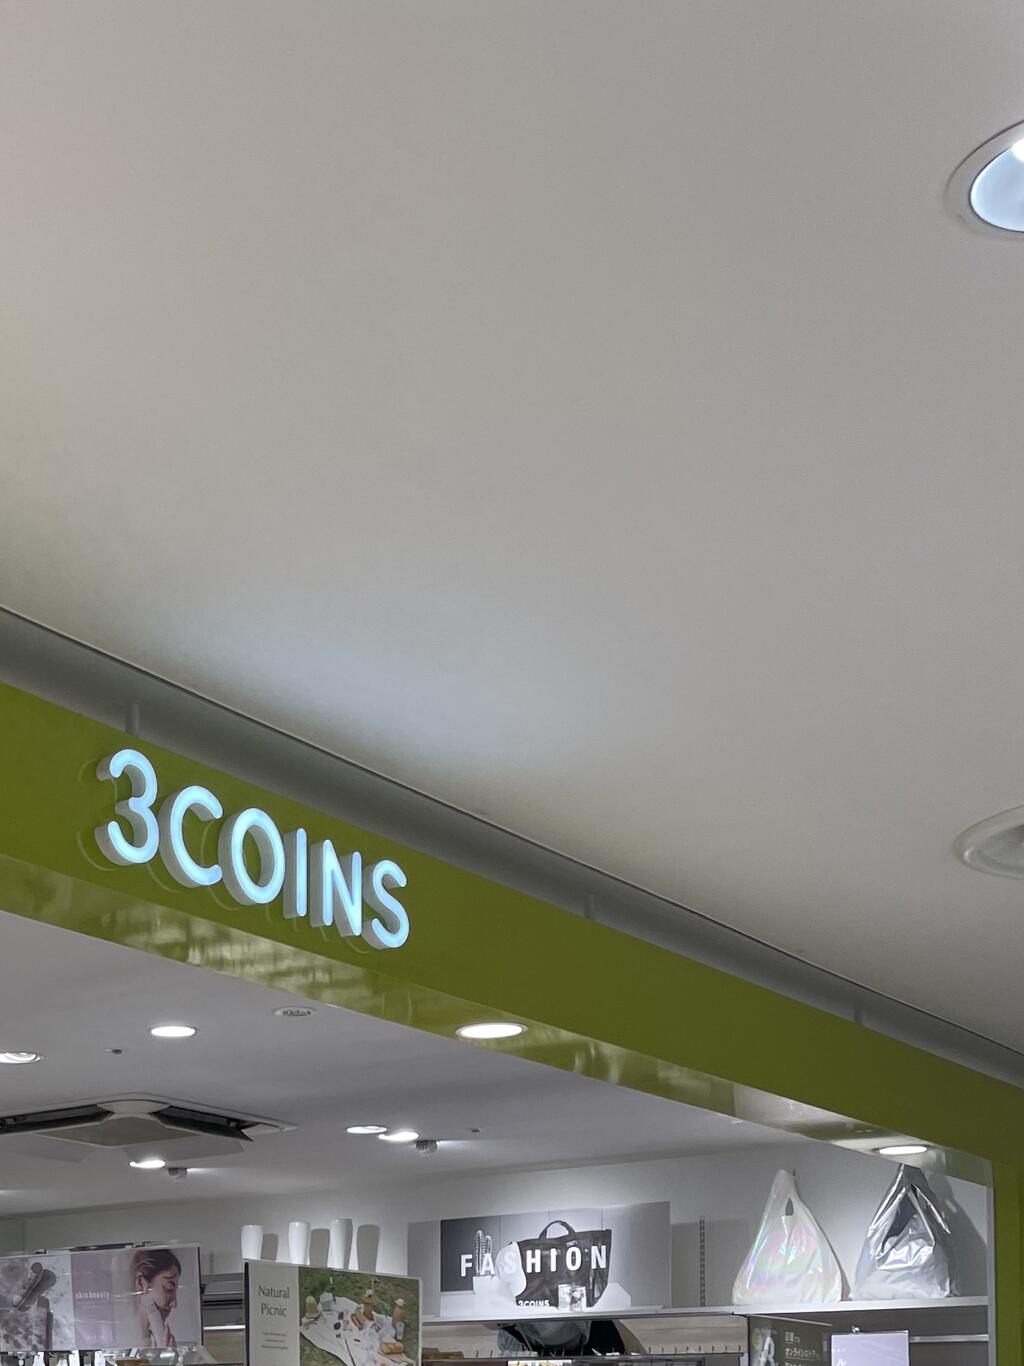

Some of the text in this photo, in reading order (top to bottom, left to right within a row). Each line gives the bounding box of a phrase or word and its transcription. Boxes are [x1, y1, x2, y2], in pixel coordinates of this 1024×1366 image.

[106, 748, 411, 949] 3COINS
[460, 1245, 607, 1278] FASHION
[258, 1285, 290, 1299] Natural
[261, 1302, 287, 1317] Picnic
